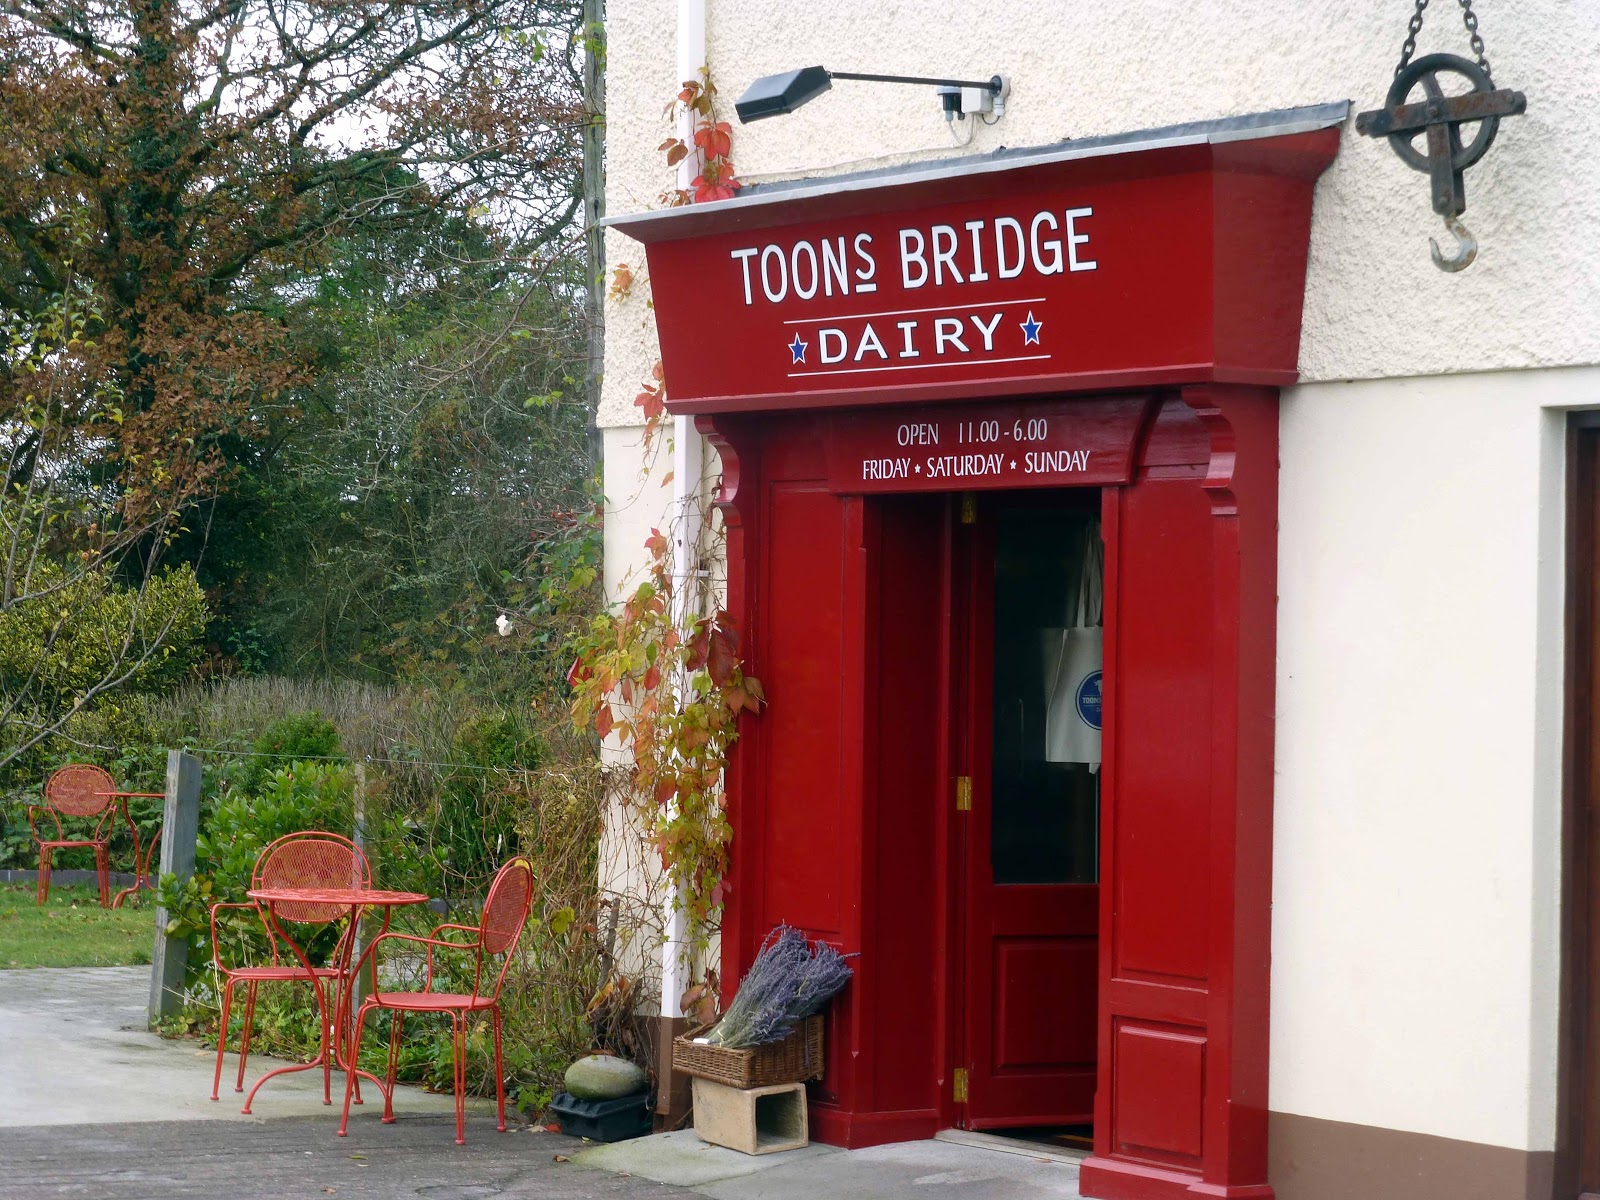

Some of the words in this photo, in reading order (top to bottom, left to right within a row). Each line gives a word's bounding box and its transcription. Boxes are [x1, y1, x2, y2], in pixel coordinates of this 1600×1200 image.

[731, 232, 877, 305] TOONS
[899, 207, 1098, 289] BRIDGE
[819, 313, 1003, 364] DAIRY
[897, 423, 939, 446] OPEN
[862, 457, 911, 480] FRIDAY
[926, 453, 1004, 477] SATURDAY
[1024, 450, 1091, 473] SUNDAY
